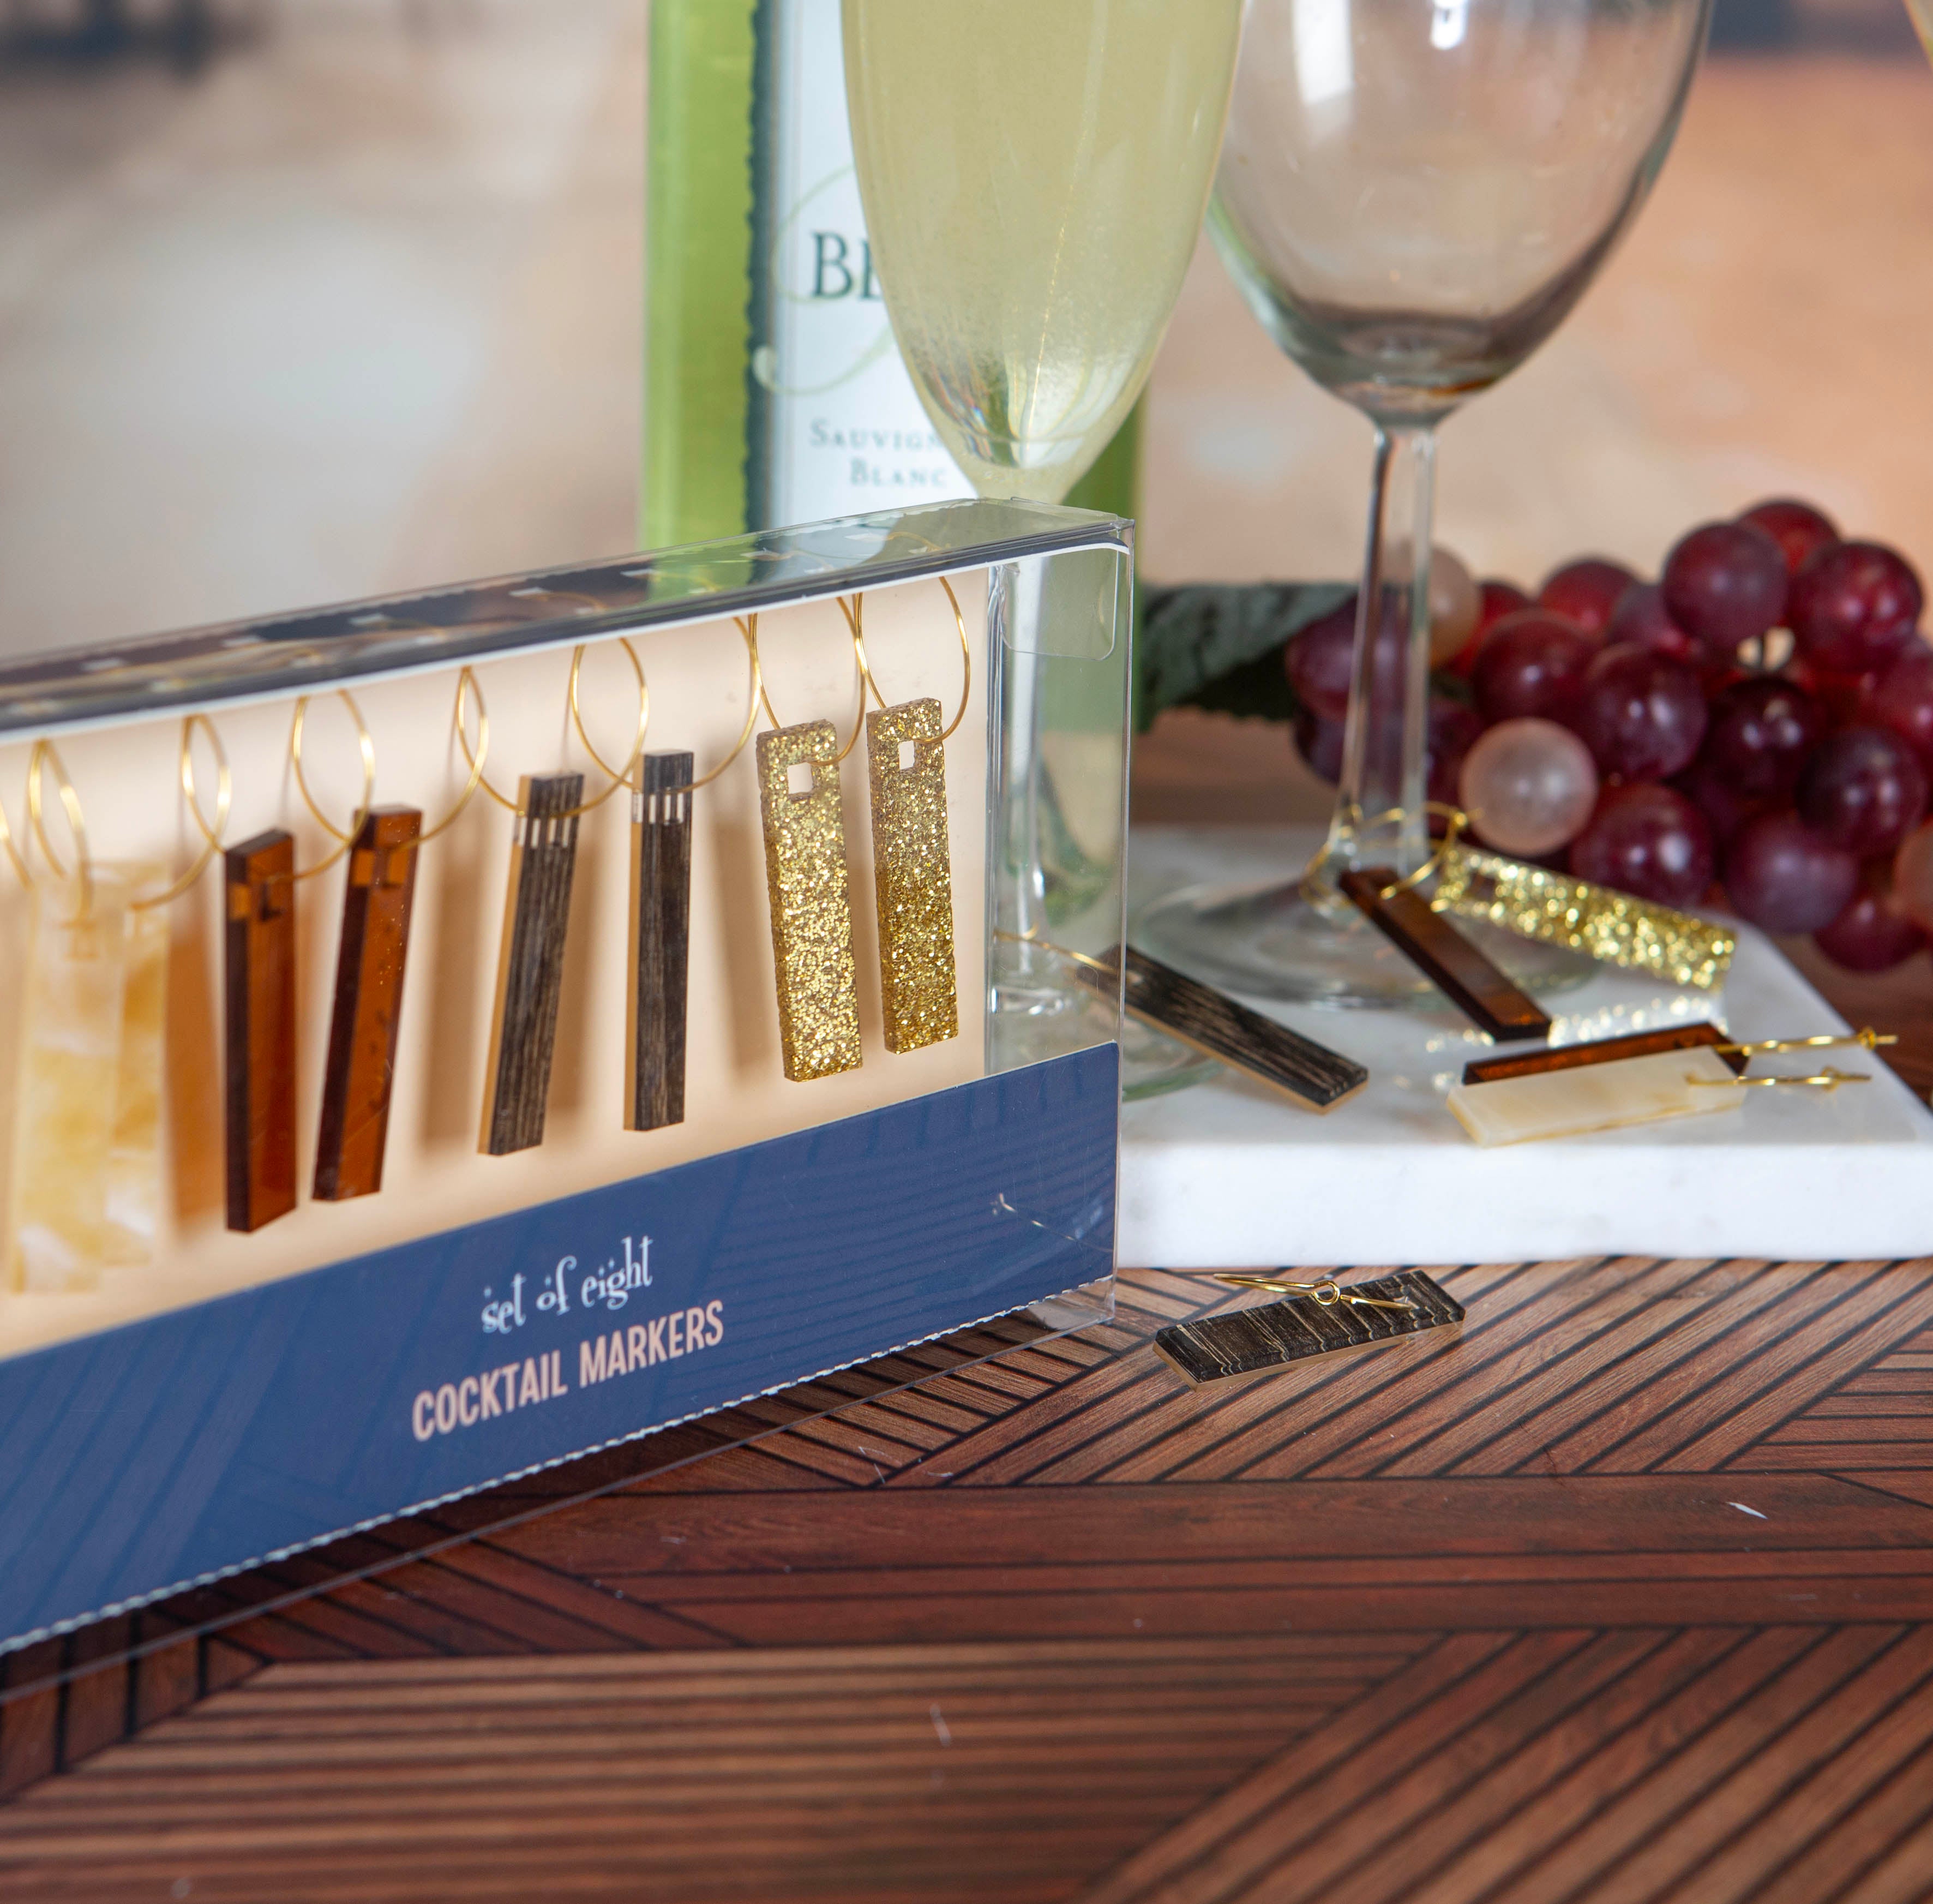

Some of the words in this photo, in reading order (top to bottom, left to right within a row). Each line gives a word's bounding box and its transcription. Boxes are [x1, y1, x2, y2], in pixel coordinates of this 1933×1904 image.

[481, 1273, 526, 1334] set
[537, 1255, 577, 1315] of
[581, 1236, 653, 1309] eight
[412, 1350, 568, 1442] COCKTAIL
[580, 1300, 724, 1388] MARKERS
